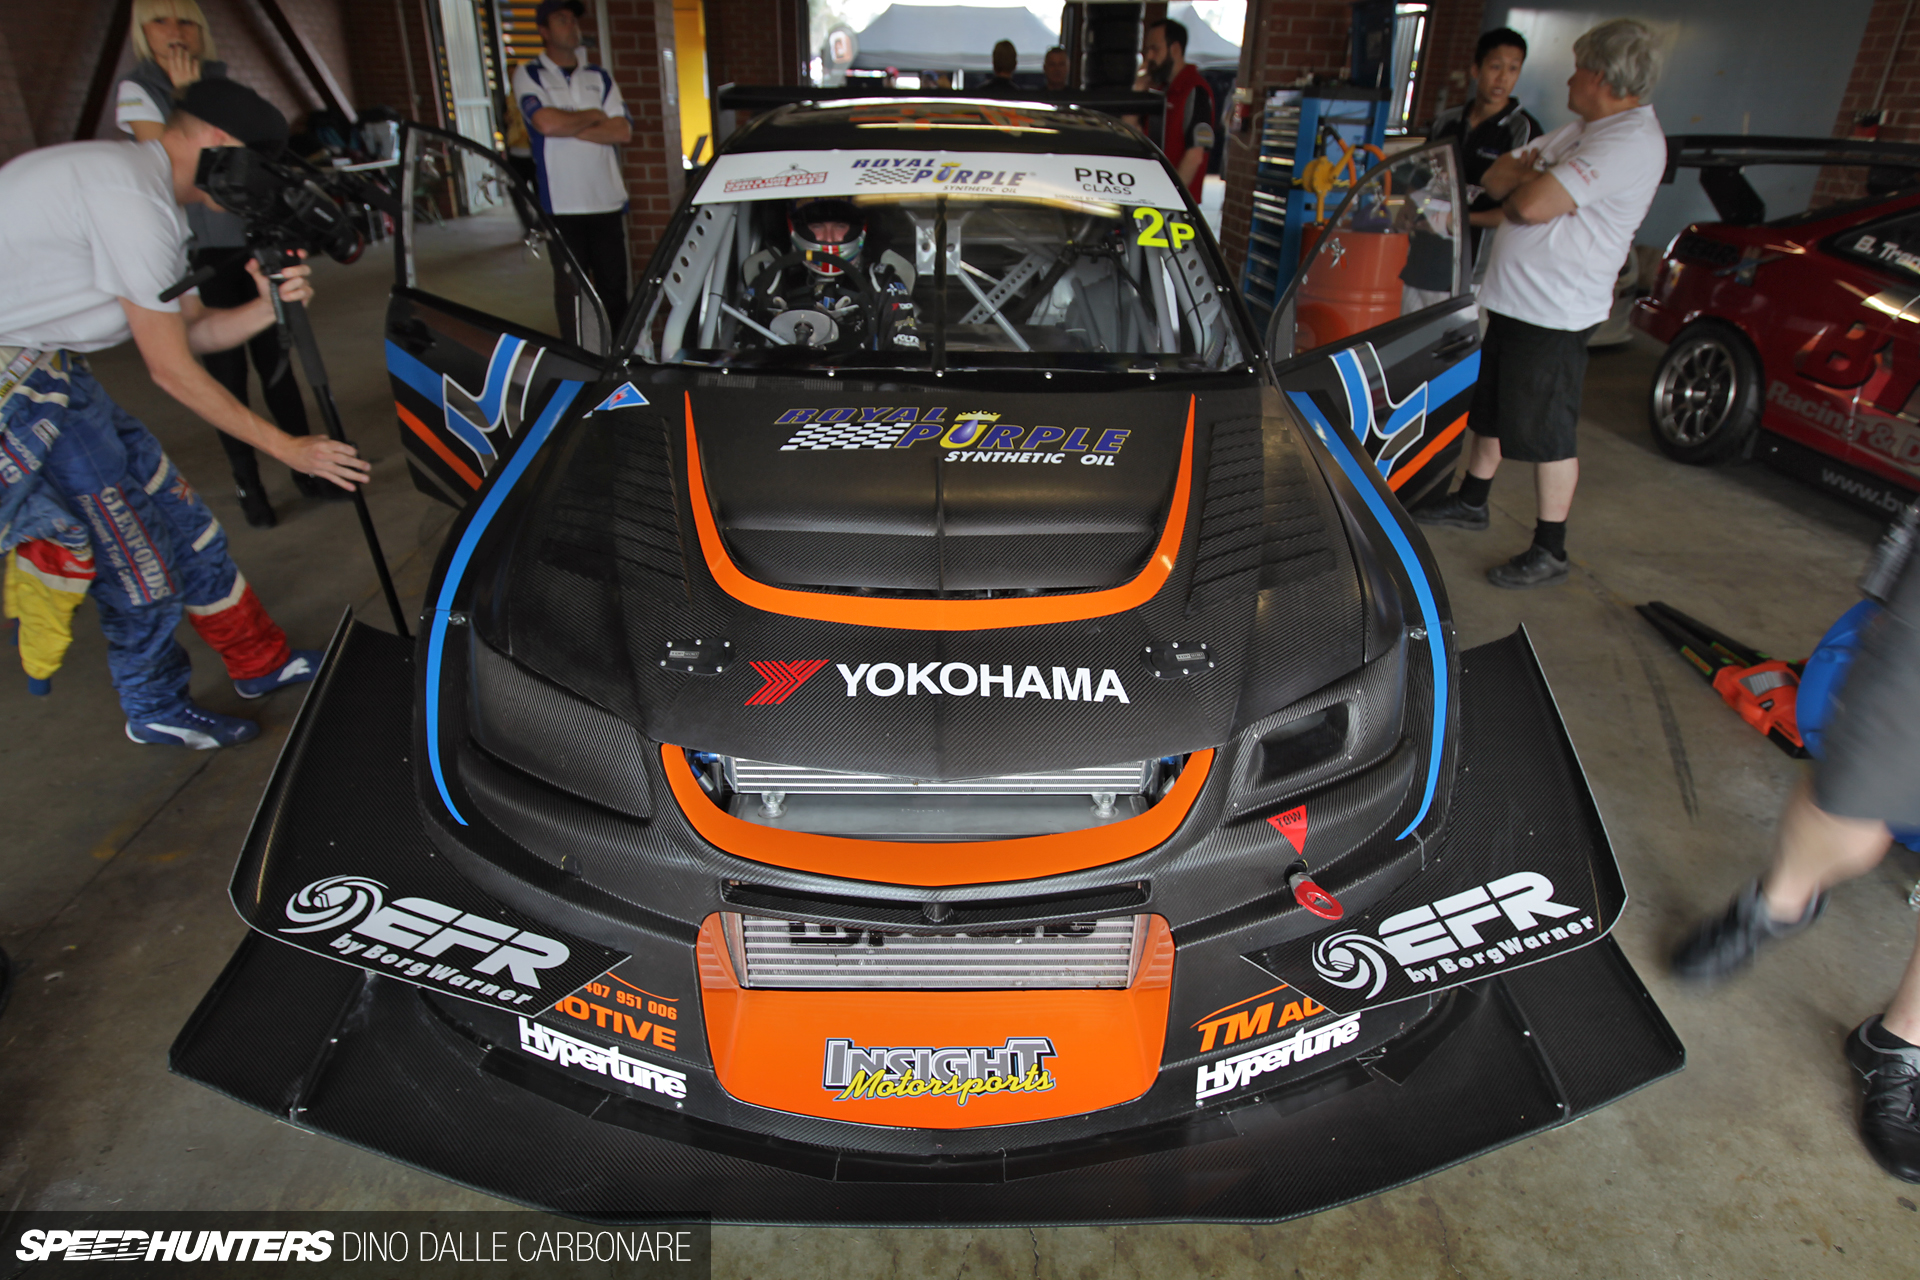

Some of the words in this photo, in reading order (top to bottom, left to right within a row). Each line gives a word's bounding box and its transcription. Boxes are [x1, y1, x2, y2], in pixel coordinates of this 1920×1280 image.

[852, 158, 935, 169] ROYAL
[911, 167, 1028, 187] PURPLE
[1074, 167, 1135, 187] PRO
[943, 184, 996, 193] SYNTHETIC
[1001, 186, 1017, 194] OIL
[1082, 183, 1132, 195] CLASS
[774, 406, 947, 424] ROYAL
[1767, 380, 1864, 442] Racing
[894, 422, 1132, 453] PURPLE
[944, 450, 1065, 464] SYNTHETIC
[1079, 453, 1116, 466] OIL
[836, 661, 1131, 705] YOKOHAMA
[1275, 810, 1302, 828] TOW
[1378, 871, 1580, 966] EFR
[352, 897, 570, 989] EFR
[1404, 964, 1438, 984] by
[1437, 915, 1596, 975] BorgWarner
[330, 933, 359, 956] by
[362, 944, 534, 1007] BorgWarner
[616, 990, 642, 1009] 951
[647, 1000, 678, 1021] 006
[1197, 1002, 1275, 1052] TM
[518, 1016, 687, 1098] Hypertune
[823, 1037, 1057, 1090] INSIGHT
[1196, 1012, 1361, 1099] Hypertune
[835, 1063, 1055, 1106] Motorsports
